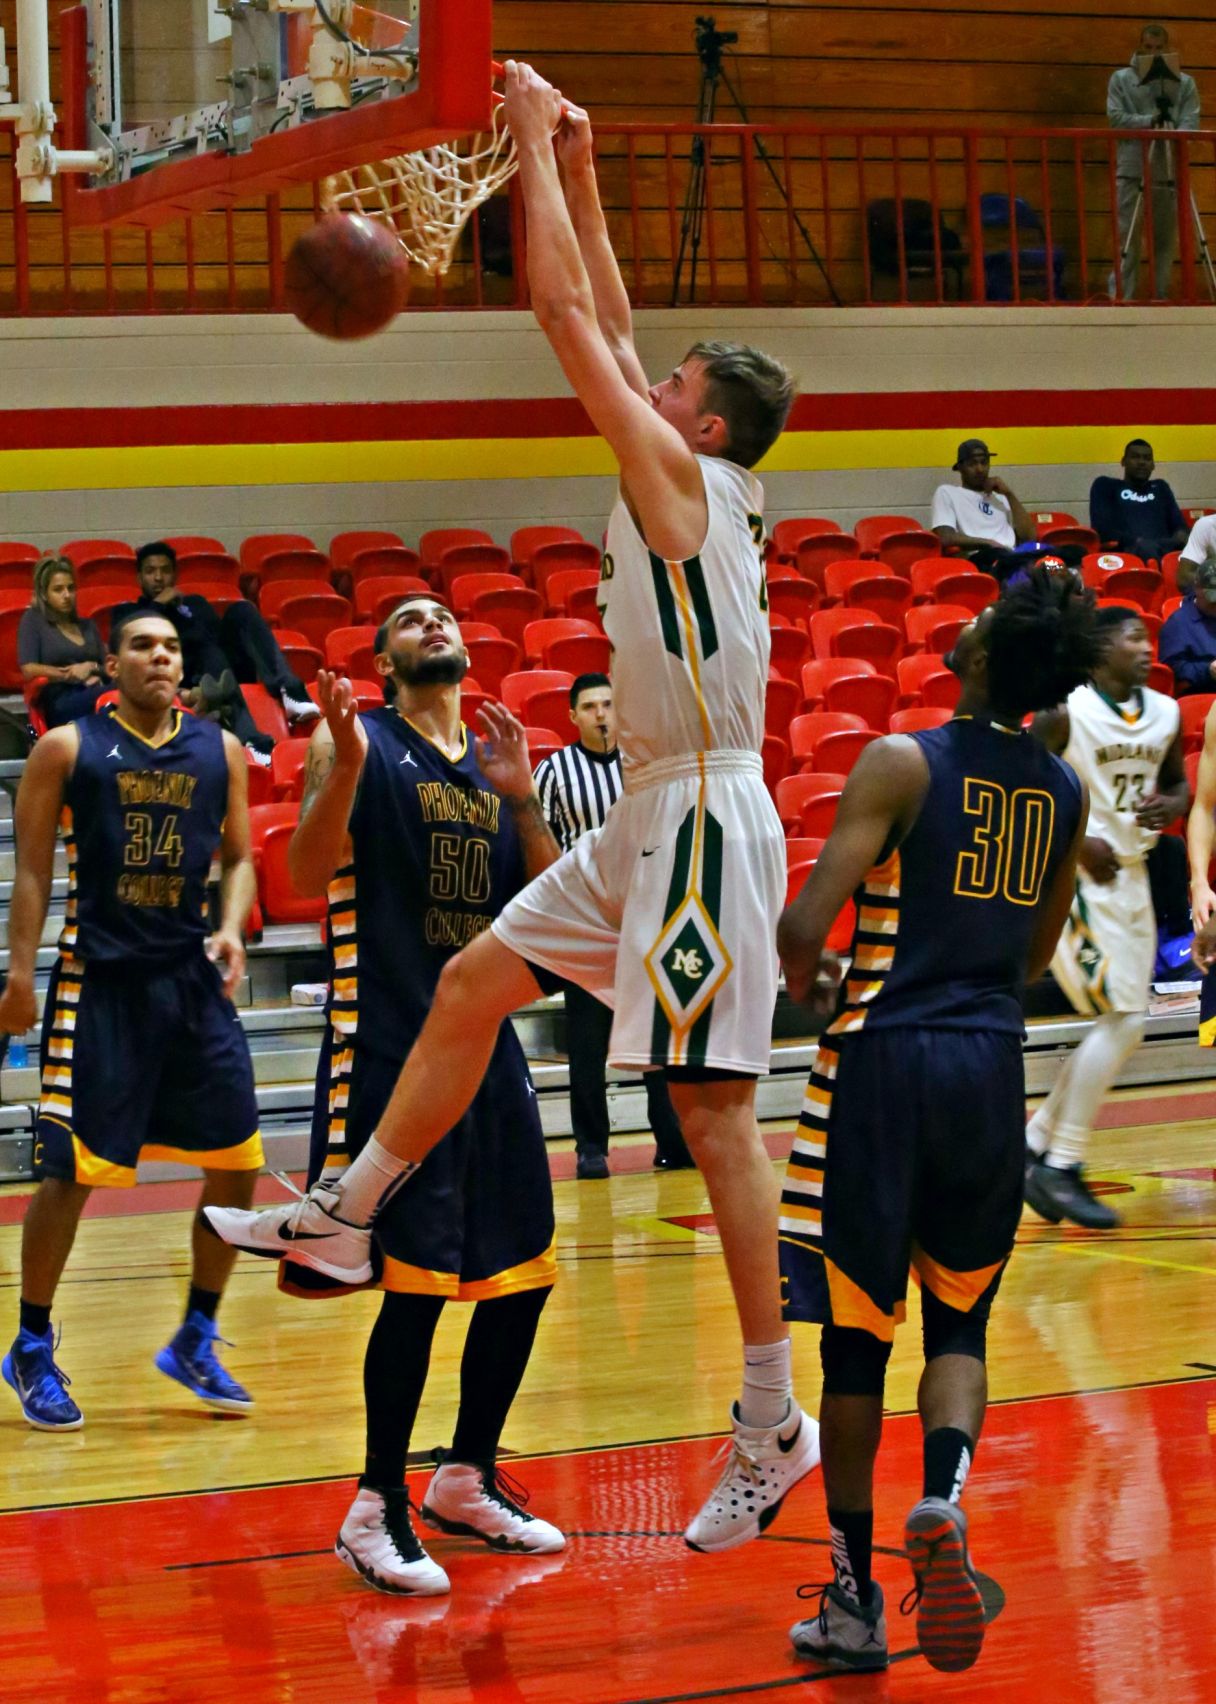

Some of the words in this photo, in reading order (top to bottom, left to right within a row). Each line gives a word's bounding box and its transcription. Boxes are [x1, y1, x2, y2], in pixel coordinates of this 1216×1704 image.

[123, 812, 184, 867] 34
[416, 782, 500, 834] PHOENIX
[430, 832, 490, 903] 50
[953, 776, 1055, 906] 30
